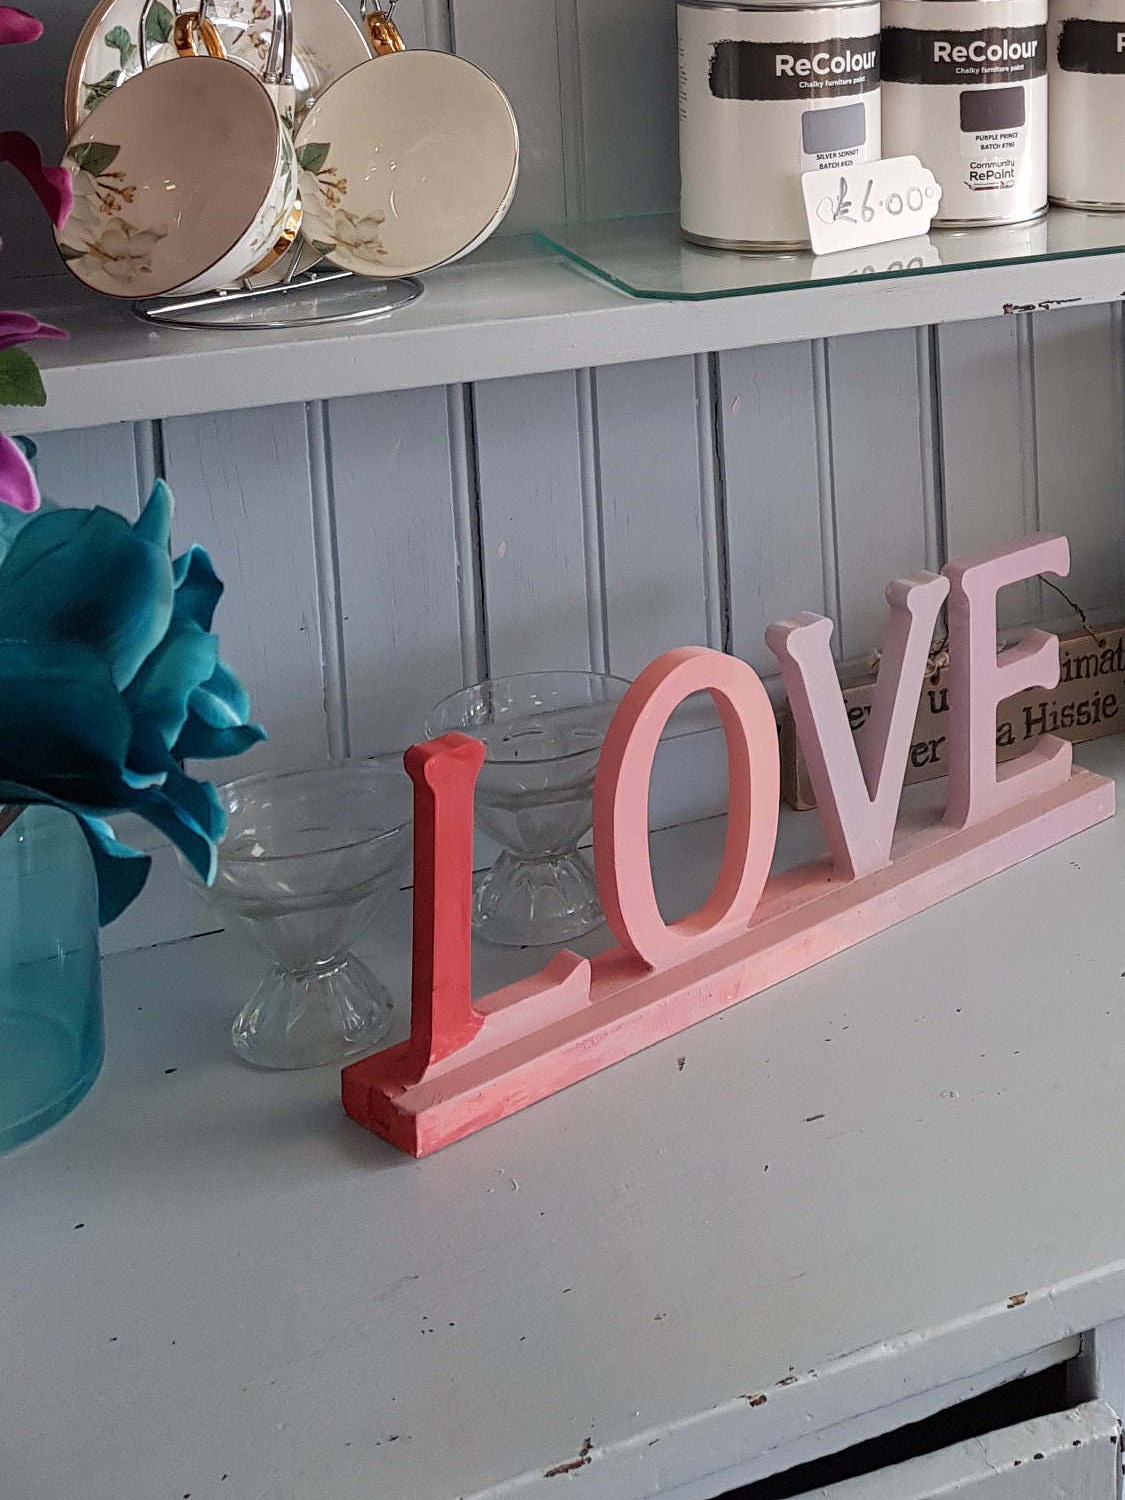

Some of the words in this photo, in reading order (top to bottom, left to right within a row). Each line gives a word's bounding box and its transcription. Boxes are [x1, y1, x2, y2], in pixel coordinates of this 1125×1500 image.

[933, 39, 1037, 63] ReColour
[775, 50, 876, 77] ReColour
[799, 80, 824, 88] Chalky
[825, 78, 852, 87] furniture
[816, 152, 837, 161] SILVER
[819, 161, 840, 169] BATCH
[970, 159, 1015, 169] Community
[970, 168, 1015, 181] RePaint
[834, 176, 923, 224] £6.00
[1023, 690, 1119, 739] Hissie
[404, 533, 1072, 1086] LOVE
